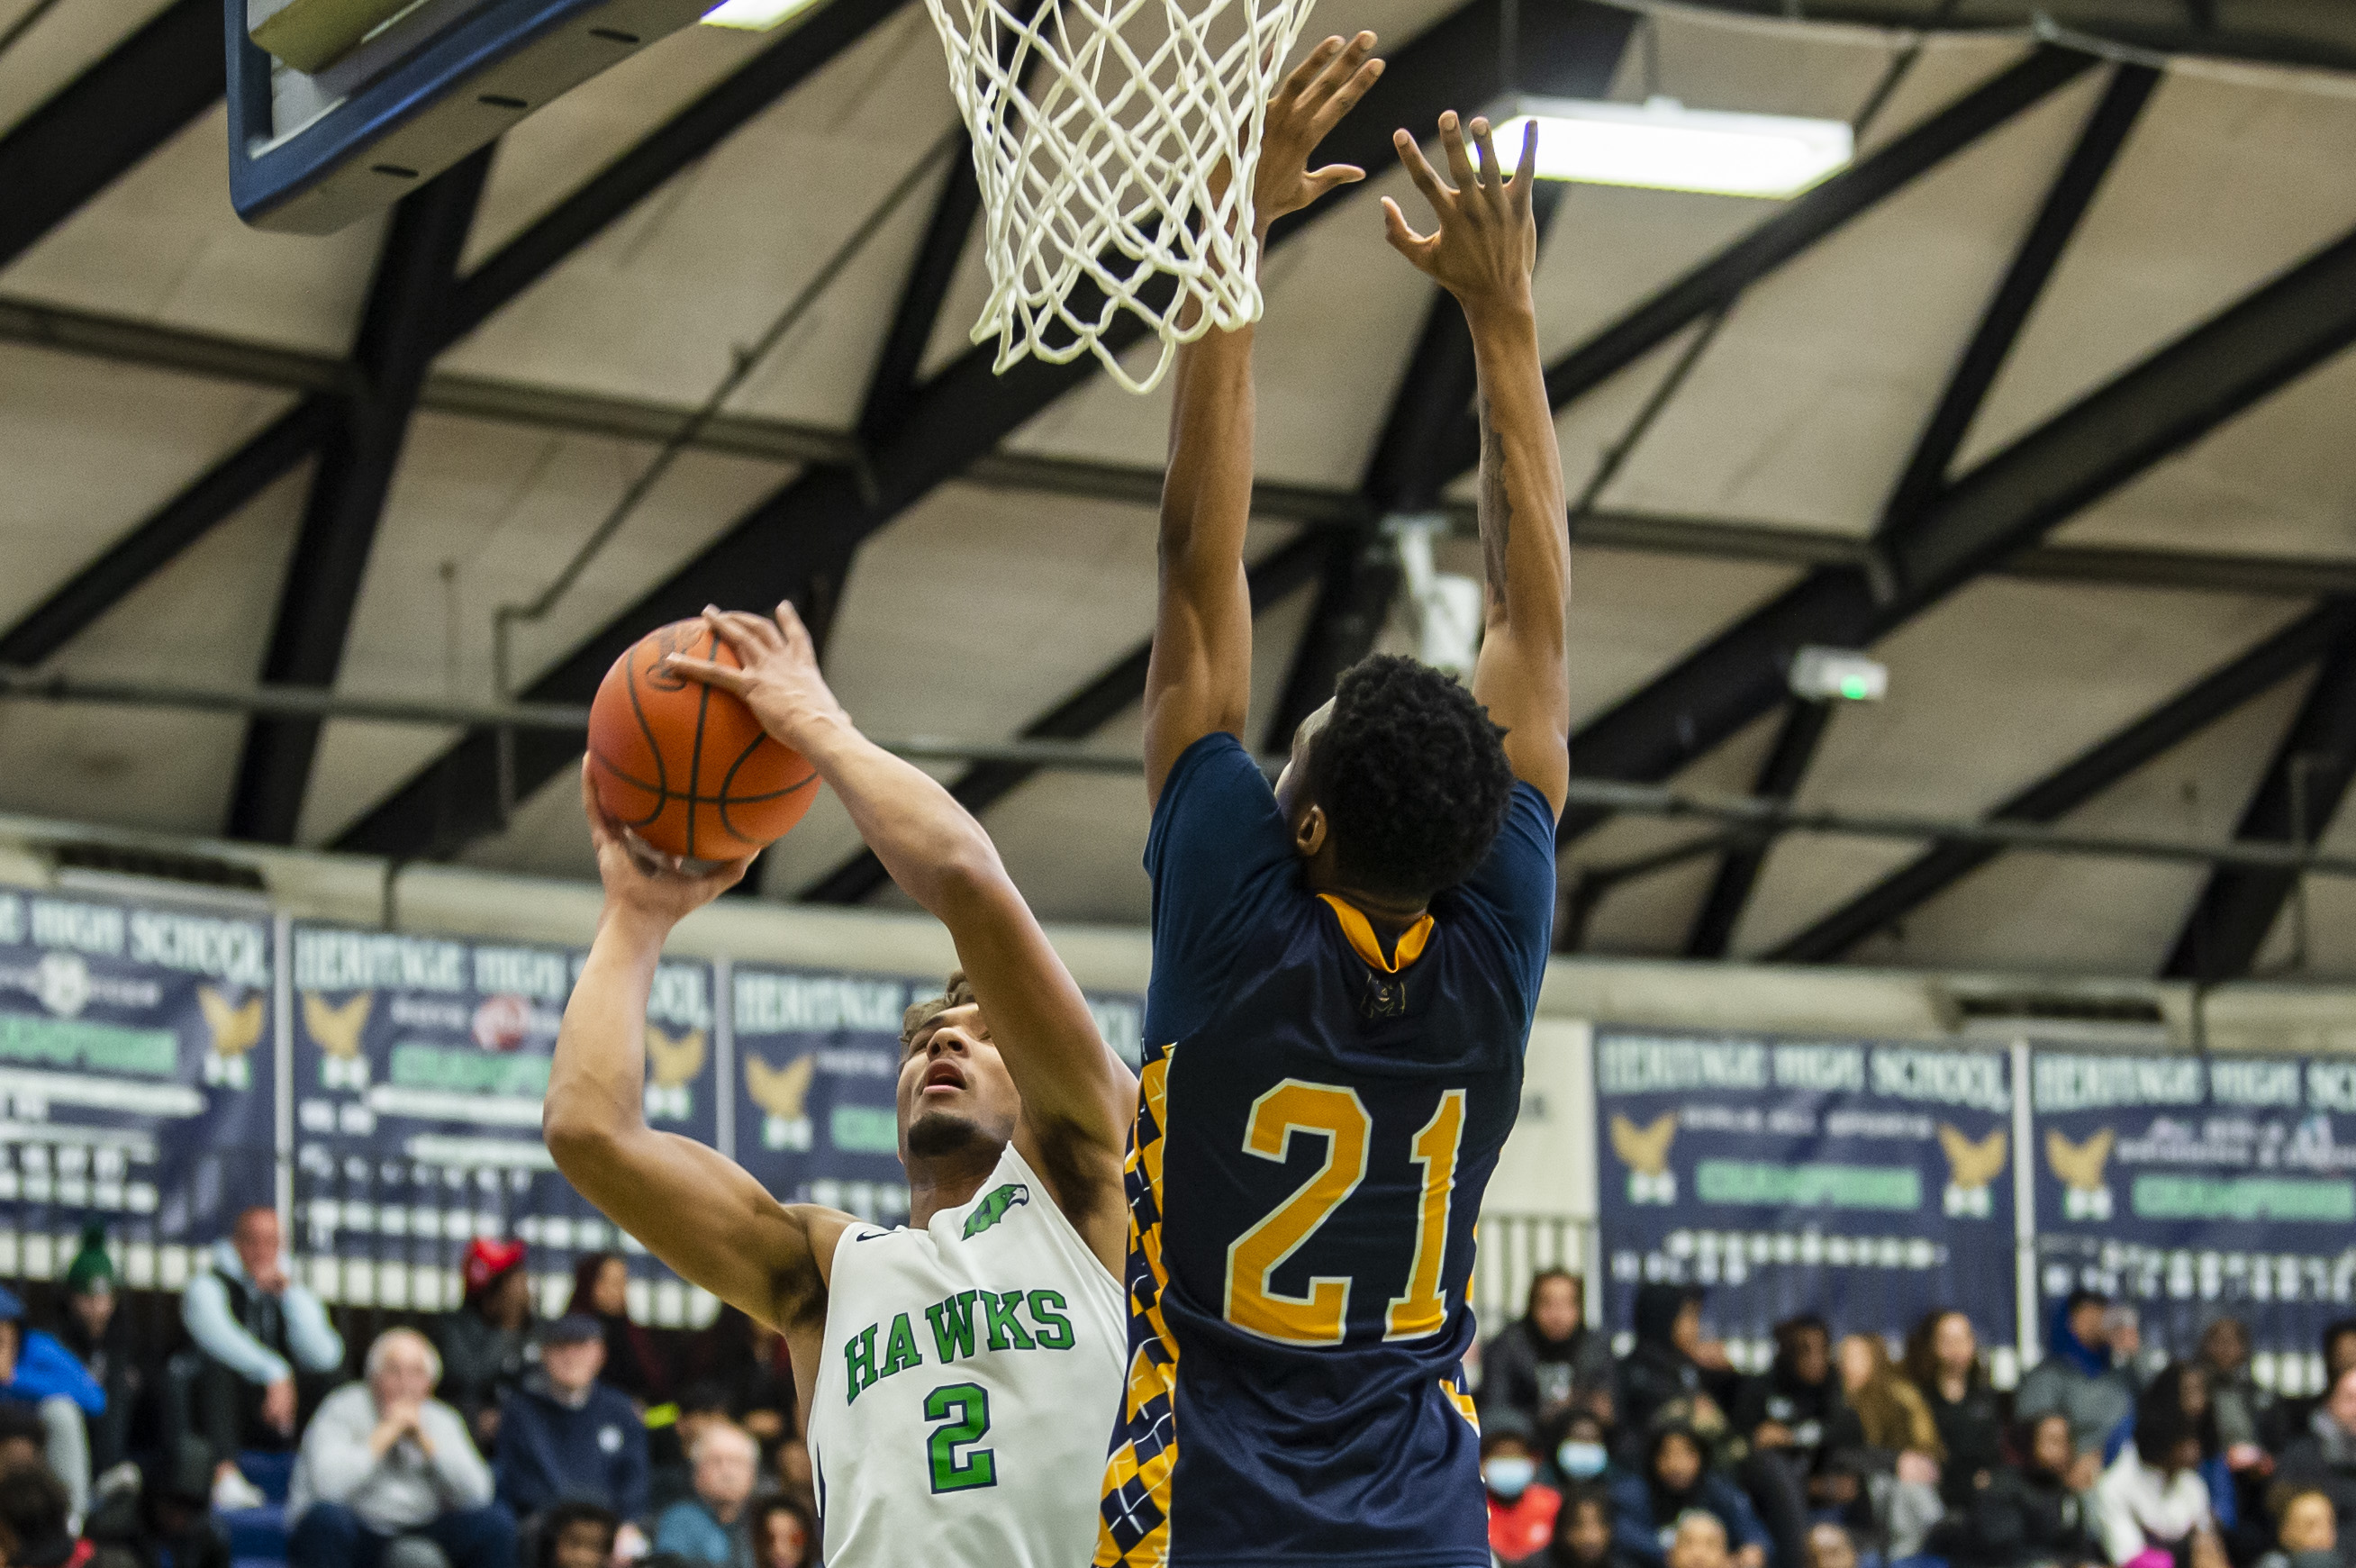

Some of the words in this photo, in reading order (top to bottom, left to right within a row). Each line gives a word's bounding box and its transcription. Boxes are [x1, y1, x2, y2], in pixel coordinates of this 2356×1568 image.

[32, 900, 124, 956] HIGH
[131, 911, 268, 987] SCHOOL
[294, 930, 461, 991] HERITAGE
[474, 948, 566, 1002] HIGH
[1600, 1038, 1765, 1094] HERITAGE
[1773, 1043, 1863, 1092] HIGH
[1871, 1049, 2011, 1113] SCHOOL
[2033, 1054, 2202, 1111] HERITAGE
[2211, 1060, 2299, 1106] HIGH
[1223, 1078, 1467, 1346] 21
[844, 1289, 1076, 1407] HAWKS
[923, 1382, 998, 1495] 2
